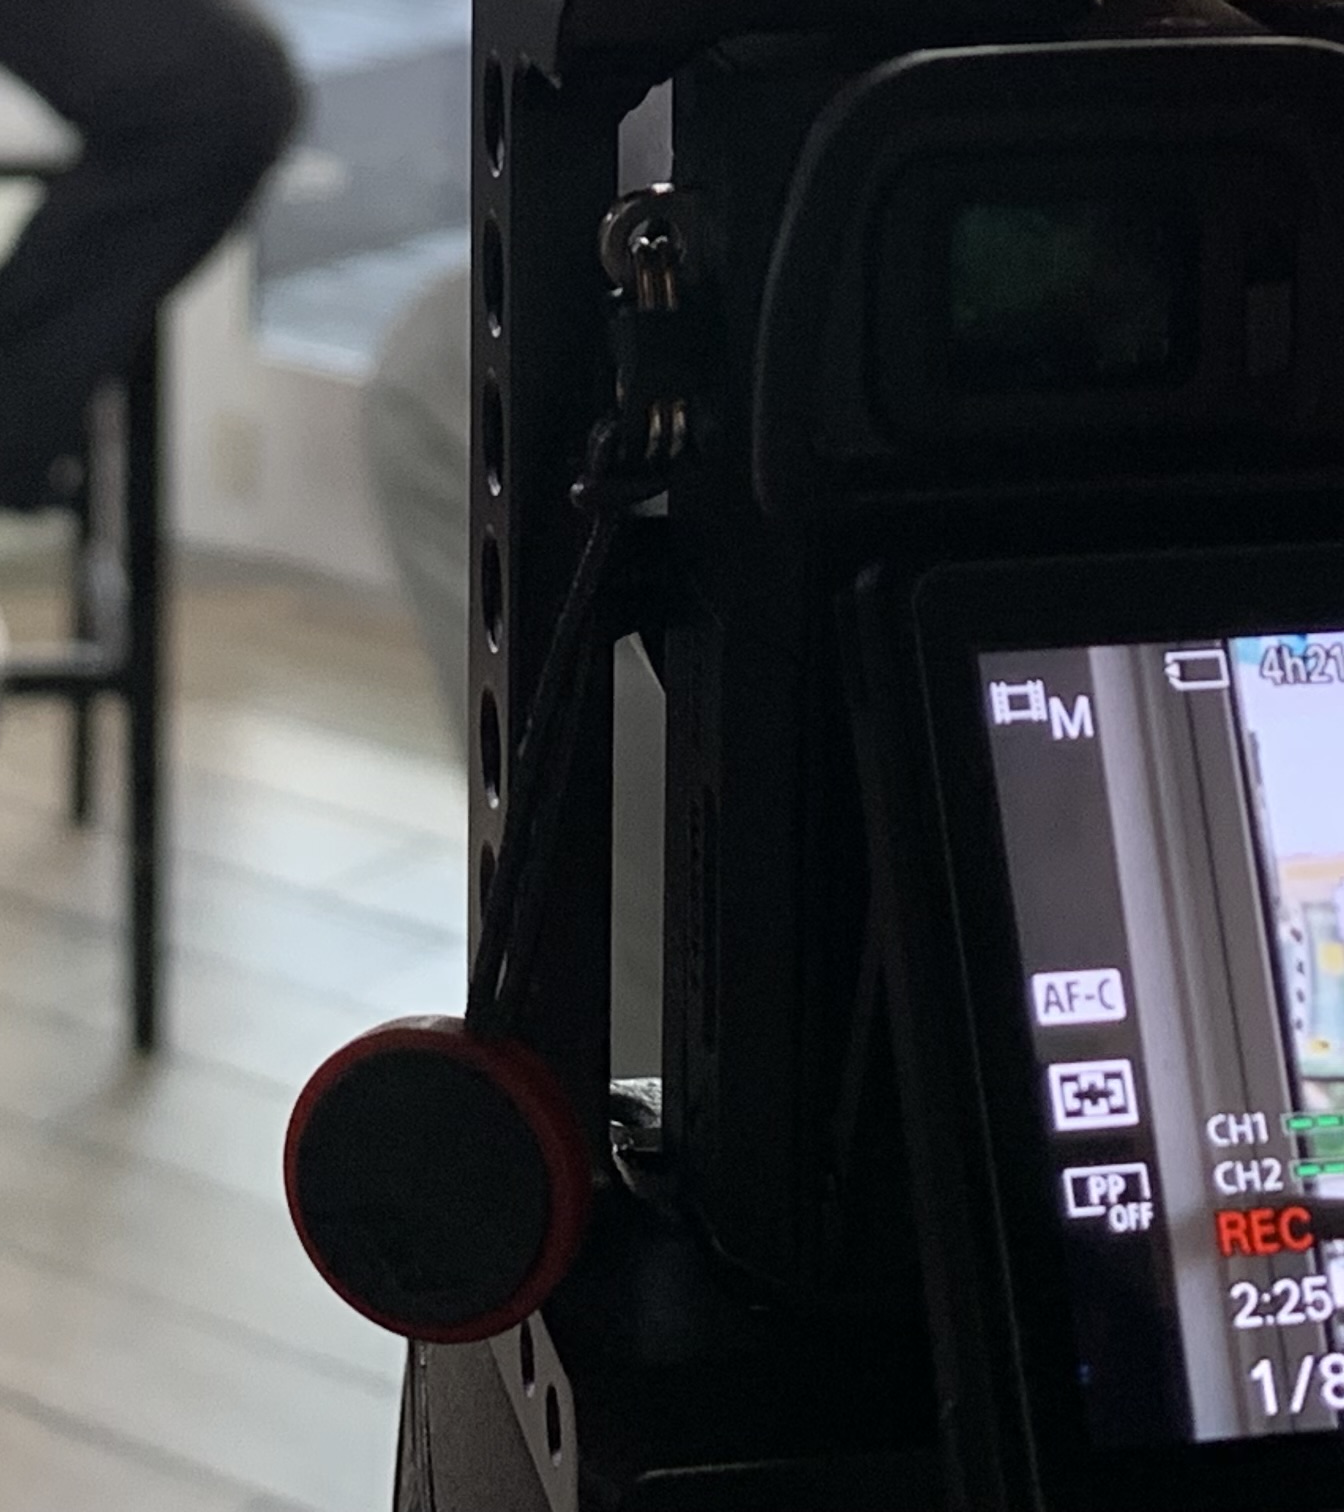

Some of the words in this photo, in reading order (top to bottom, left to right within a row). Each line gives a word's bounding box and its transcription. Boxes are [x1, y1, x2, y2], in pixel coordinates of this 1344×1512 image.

[1052, 696, 1095, 740] M
[1042, 976, 1117, 1012] AF-C
[1207, 1111, 1269, 1148] CH1
[1087, 1173, 1126, 1205] PP
[1213, 1158, 1284, 1195] CH2
[1109, 1201, 1154, 1233] OFF
[1216, 1205, 1314, 1257] REC
[1229, 1275, 1334, 1330] 2:25
